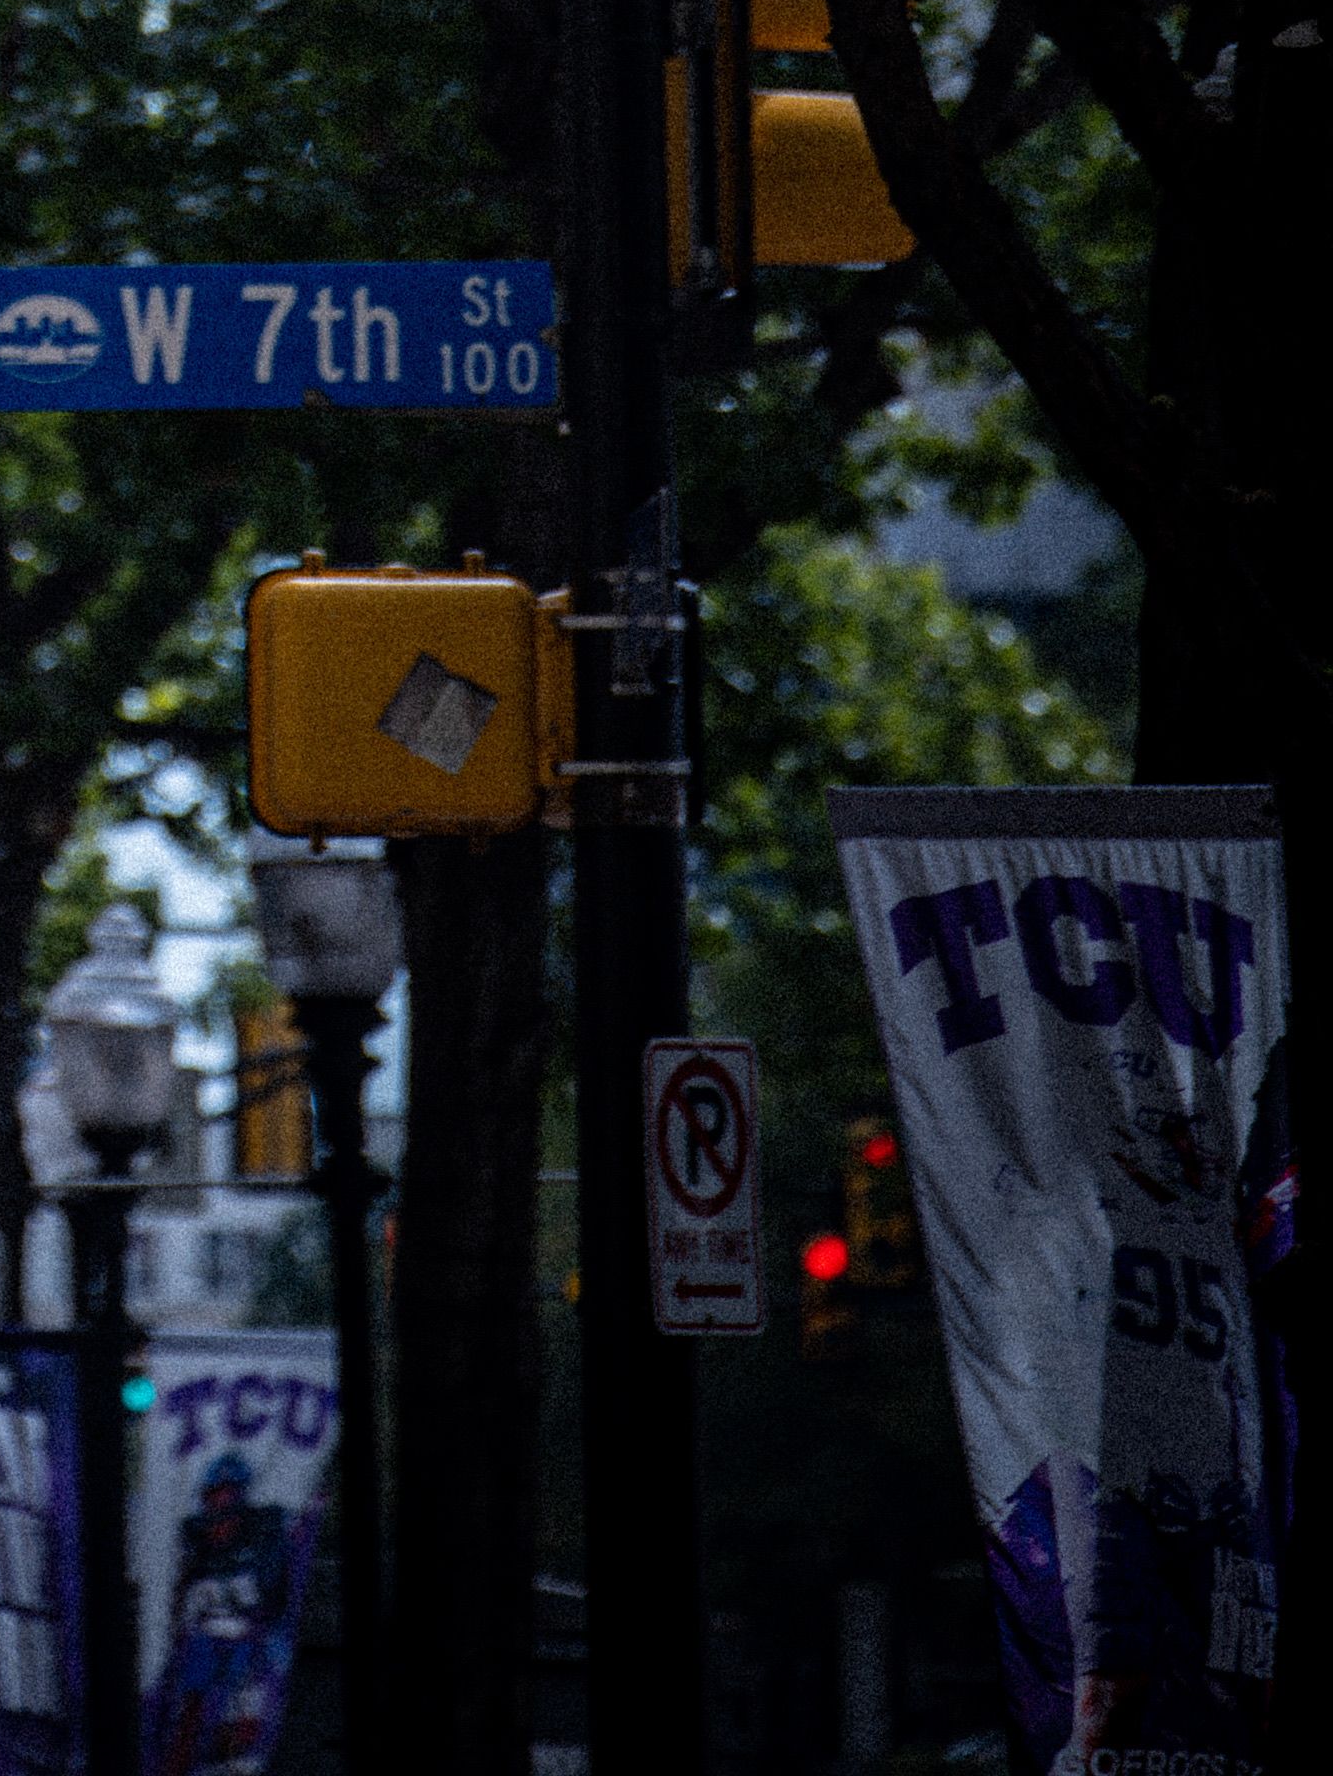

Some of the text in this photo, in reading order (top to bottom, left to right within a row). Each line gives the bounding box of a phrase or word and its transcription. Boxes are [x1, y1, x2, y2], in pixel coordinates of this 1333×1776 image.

[119, 285, 402, 385] W 7th
[462, 275, 514, 327] St
[440, 342, 539, 394] 100
[889, 874, 1256, 1060] TCU
[1111, 1244, 1231, 1363] 95
[160, 1374, 340, 1460] TCU
